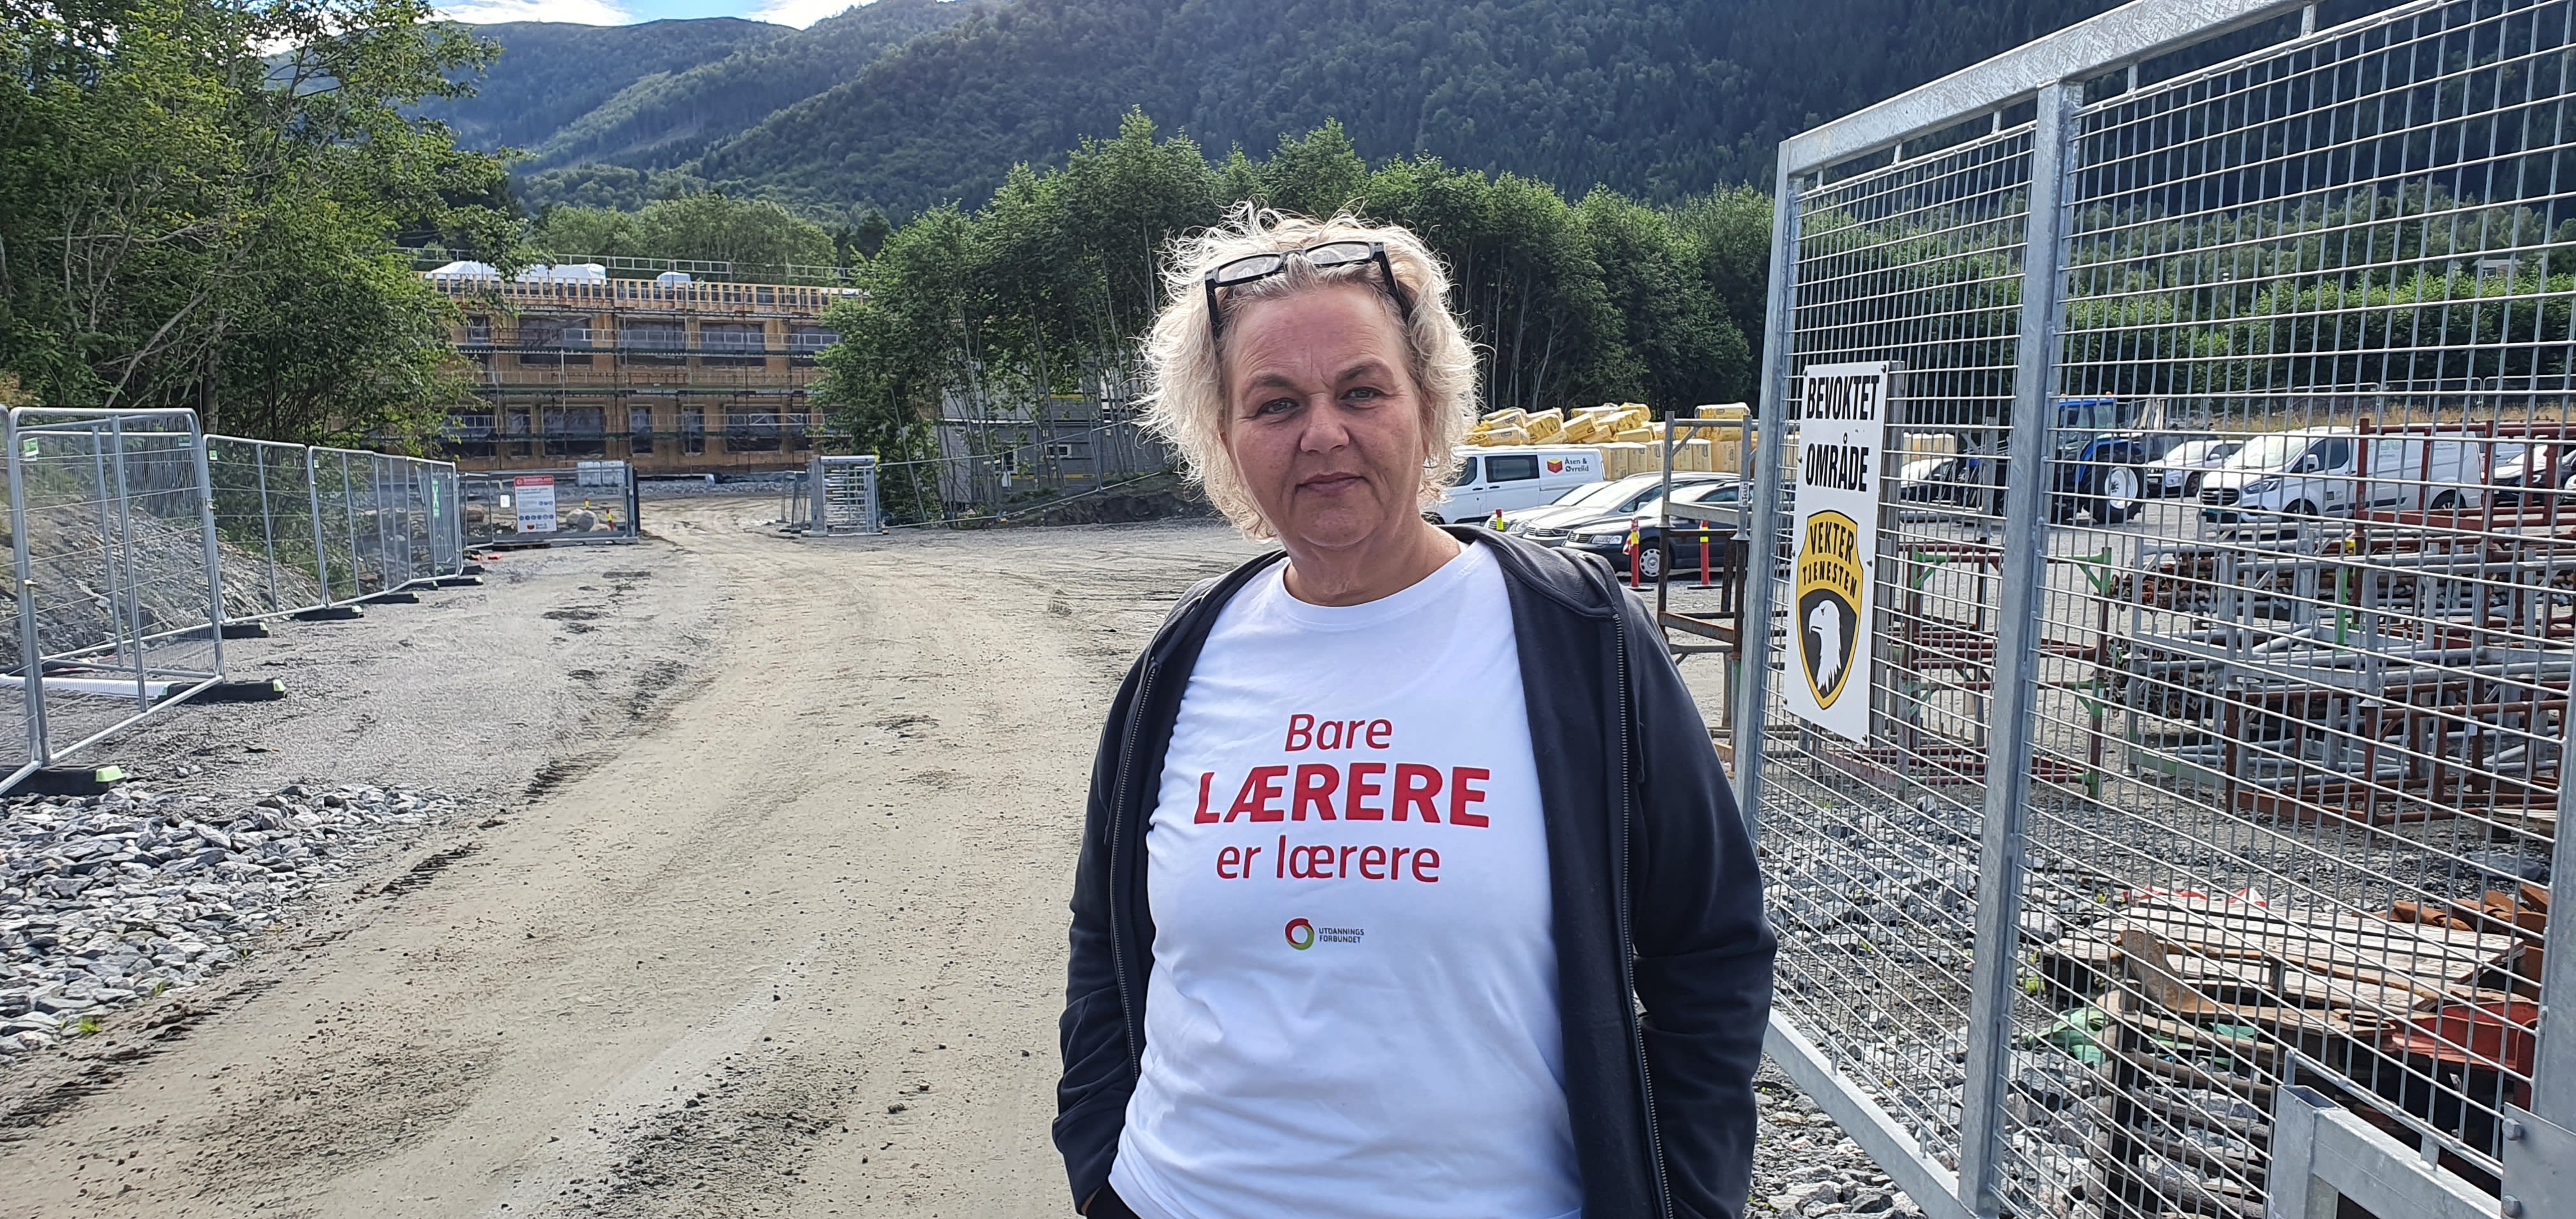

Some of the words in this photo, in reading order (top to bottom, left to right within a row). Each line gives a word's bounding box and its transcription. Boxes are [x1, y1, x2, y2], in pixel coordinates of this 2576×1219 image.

[1806, 375, 1880, 420] BEVOKTET
[1565, 456, 1581, 464] Åsen
[1805, 432, 1869, 492] OMRÅDE
[1809, 521, 1855, 565] VEKTER
[1802, 560, 1857, 599] TJENESTEN
[1285, 714, 1393, 752] Bare
[1194, 762, 1491, 828] LÆRERE
[1216, 846, 1262, 879] er
[1276, 835, 1440, 883] lærere
[1319, 927, 1365, 935] UTDANNINGS
